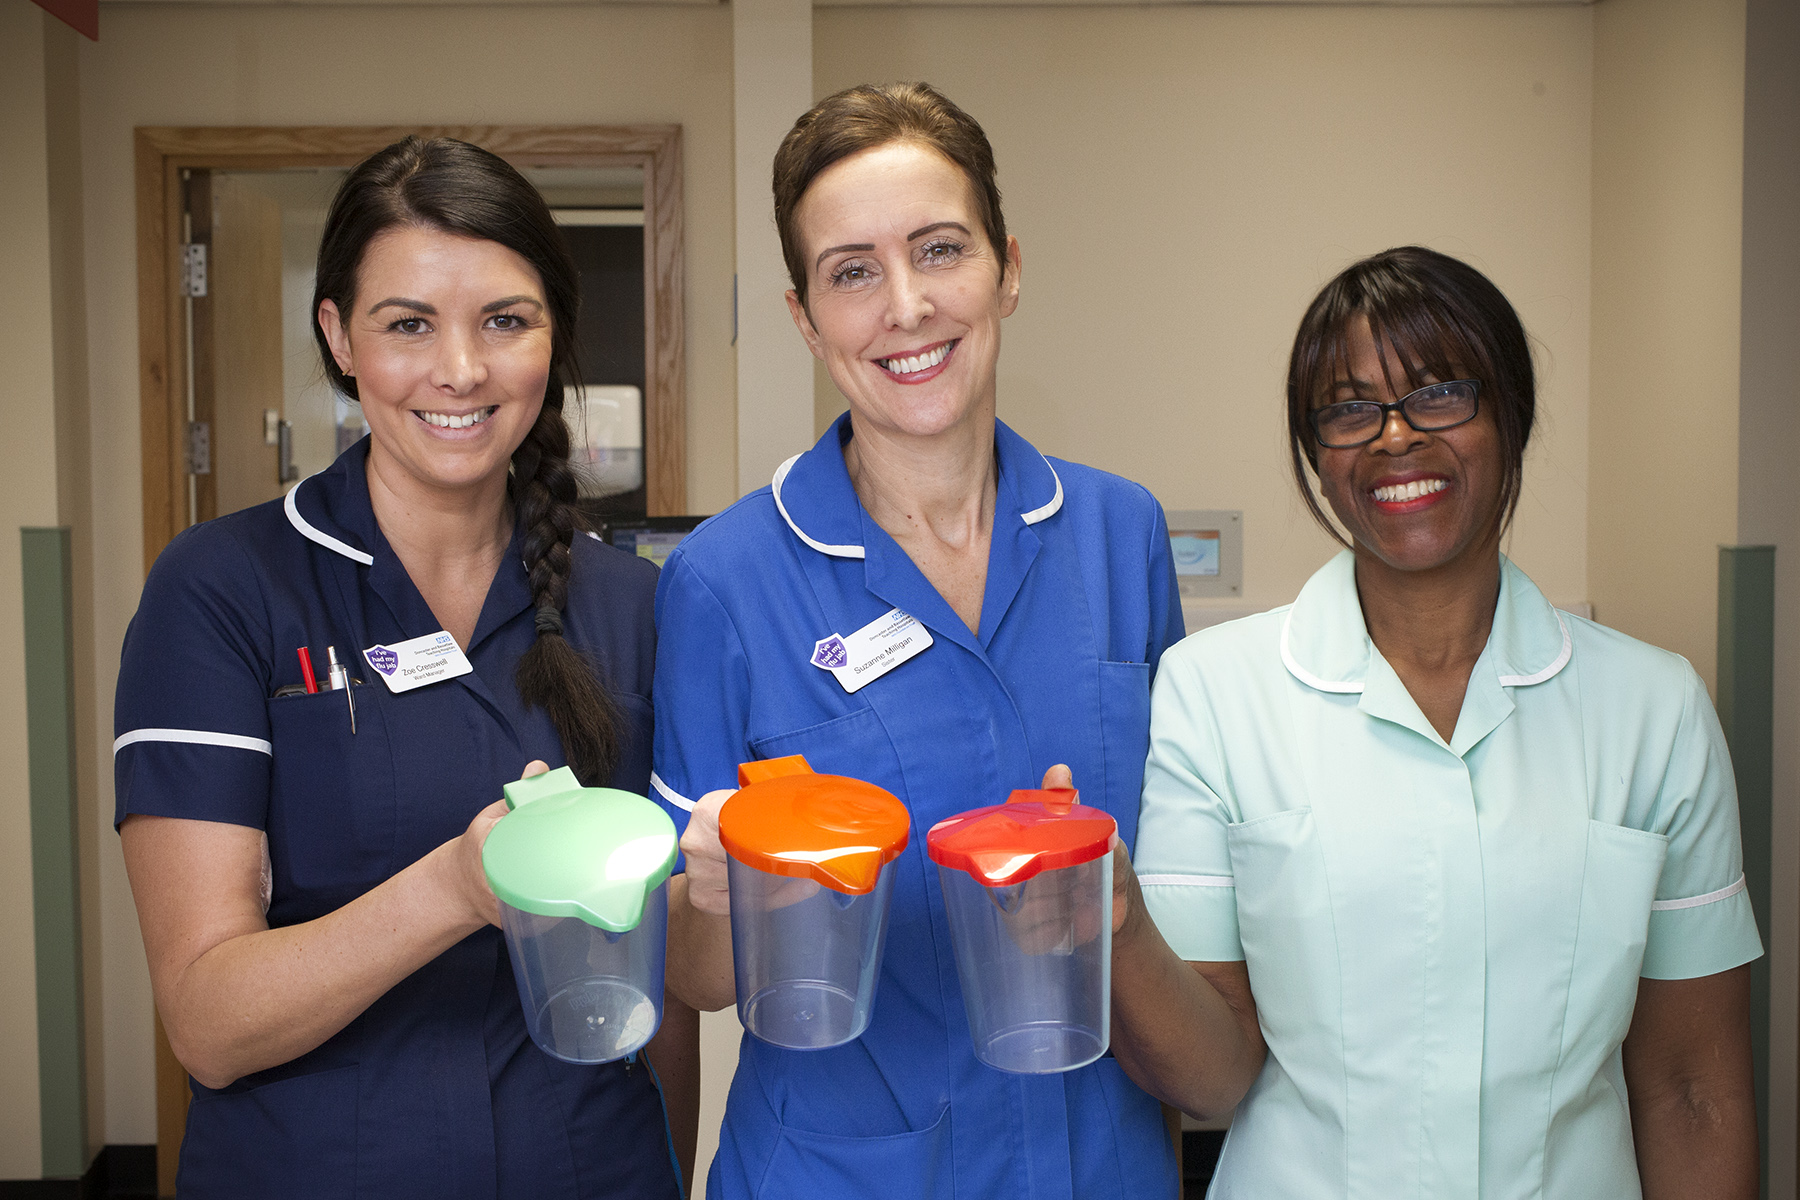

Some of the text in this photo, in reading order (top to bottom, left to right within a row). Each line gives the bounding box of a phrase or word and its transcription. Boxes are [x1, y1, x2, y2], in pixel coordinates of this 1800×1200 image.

[819, 643, 831, 654] I've
[820, 643, 842, 664] had my
[853, 636, 914, 675] Suzanne Milligan
[386, 662, 397, 670] jab
[828, 649, 846, 667] flu jab
[401, 658, 449, 677] Zoe Cresswell
[426, 669, 445, 678] Manager
